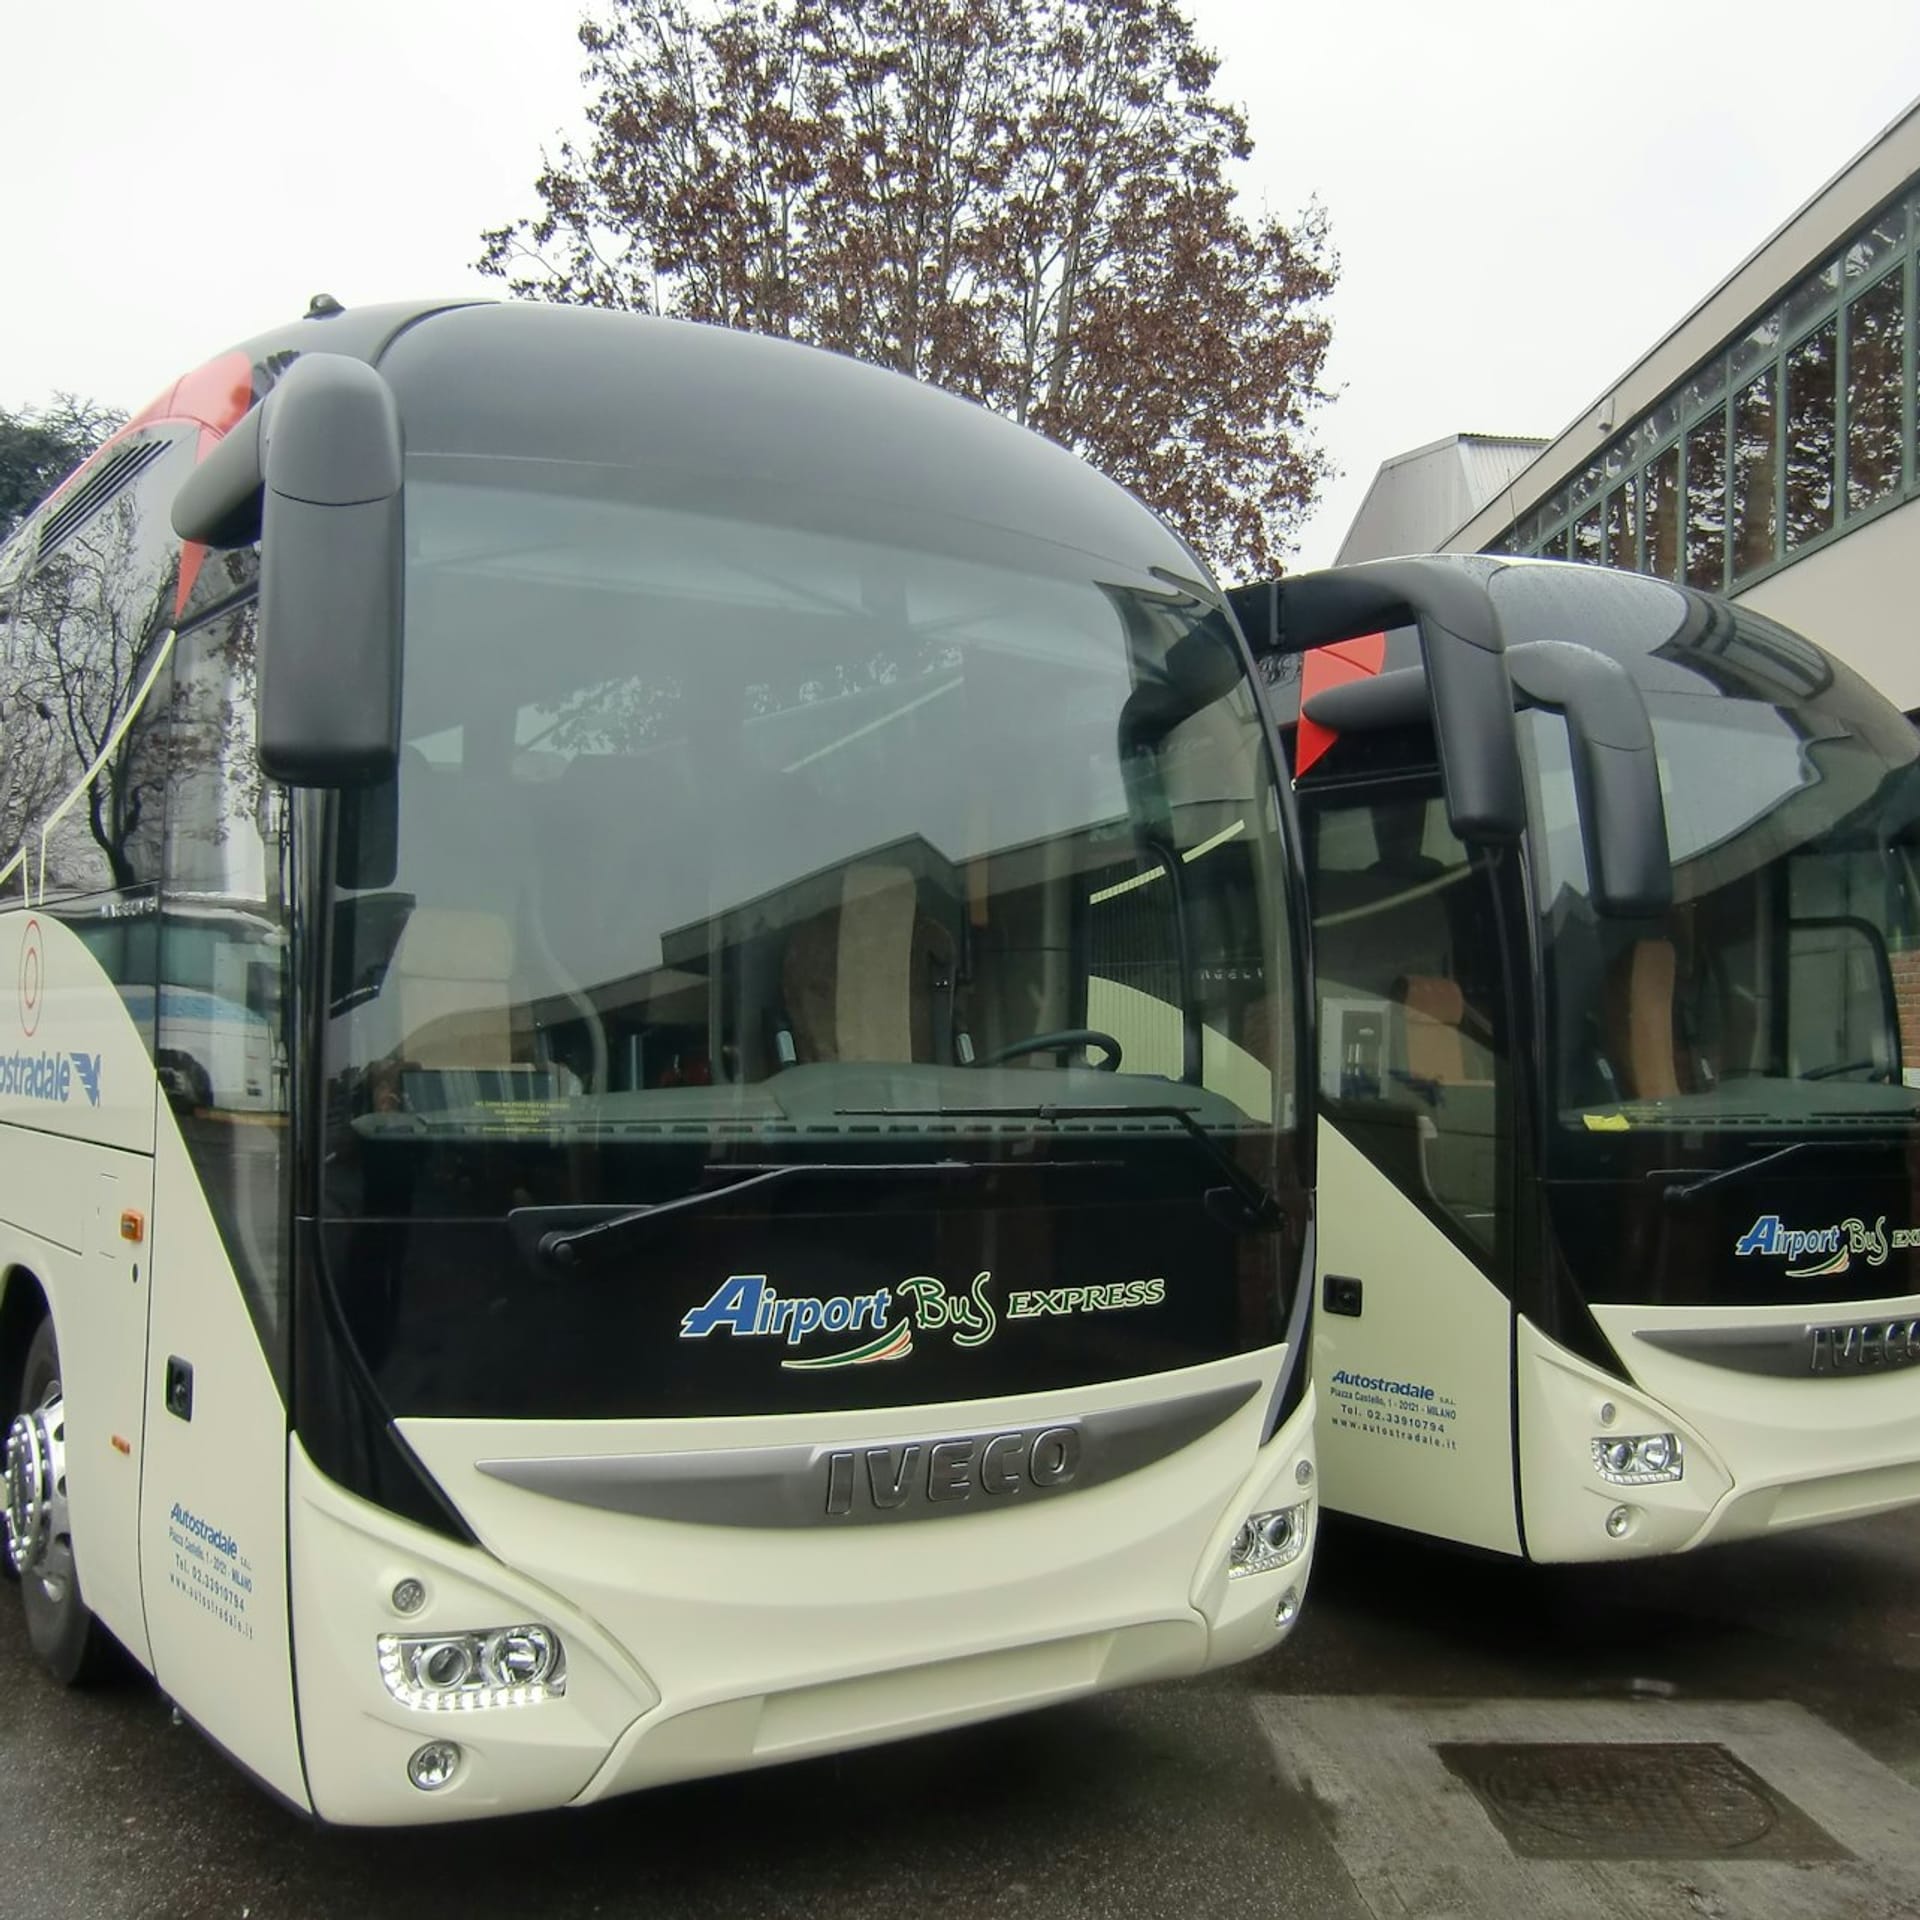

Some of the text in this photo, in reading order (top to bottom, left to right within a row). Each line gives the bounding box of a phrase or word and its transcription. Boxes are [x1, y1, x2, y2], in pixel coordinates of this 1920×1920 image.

[1735, 1215, 1840, 1261] Airport
[679, 1274, 892, 1344] Airport
[1006, 1278, 1166, 1319] EXPRESS
[1332, 1370, 1435, 1401] Autostradale
[1341, 1404, 1444, 1433] Tel. 02.33910794
[1426, 1405, 1457, 1420] MILANO
[1331, 1417, 1457, 1450] www.autostradale.it
[826, 1424, 1082, 1515] IVECO
[170, 1502, 238, 1560] Autostradale
